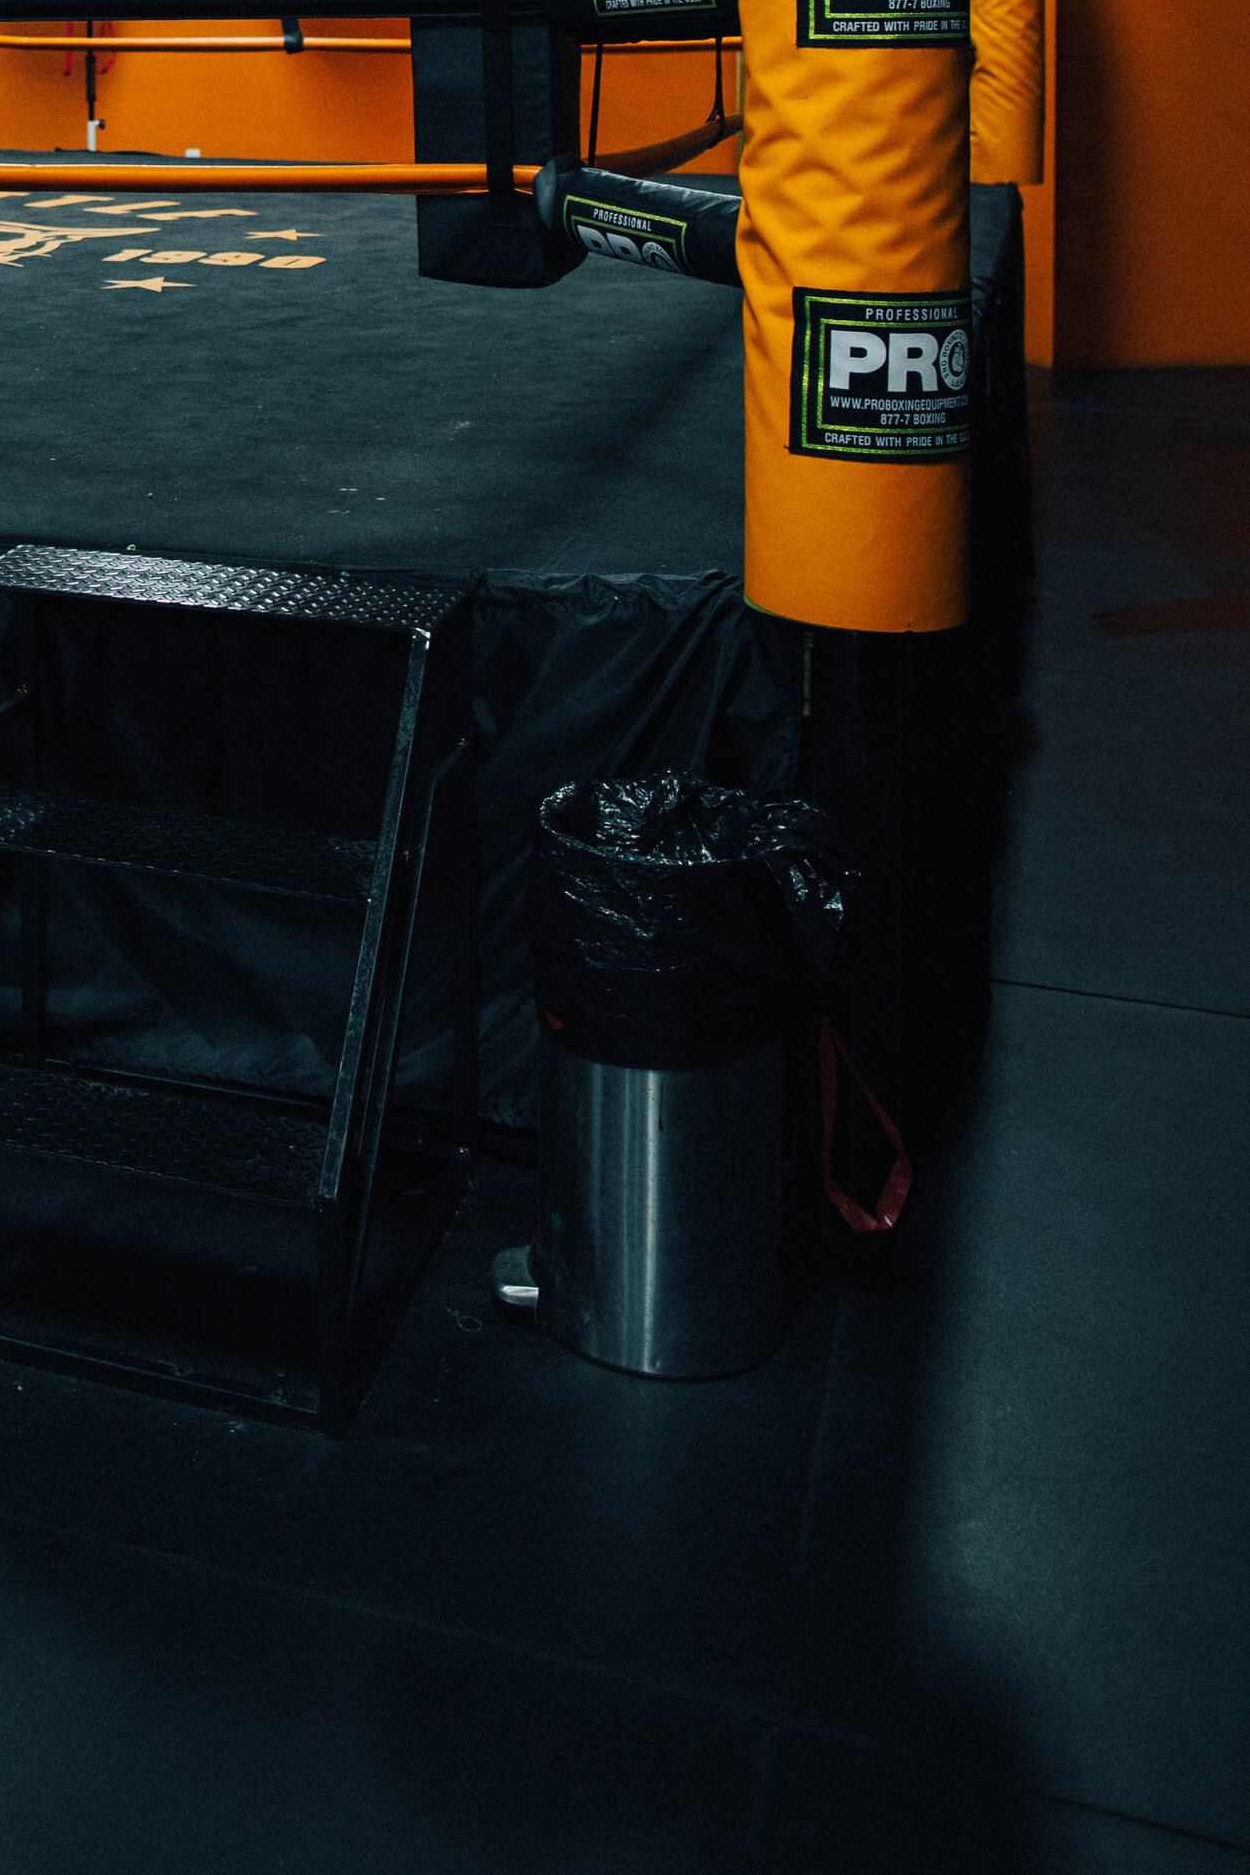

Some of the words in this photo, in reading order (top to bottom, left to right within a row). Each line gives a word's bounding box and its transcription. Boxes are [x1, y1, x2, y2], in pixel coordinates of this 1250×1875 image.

[606, 0, 629, 10] CRAFTED
[833, 21, 880, 32] CRAFTED
[884, 21, 910, 32] WITH
[914, 21, 938, 31] PRIDE
[941, 20, 948, 30] IN
[593, 208, 652, 232] PROFESSIONAL
[101, 248, 327, 269] 1990
[866, 307, 958, 321] PROFESSIONAL
[829, 329, 969, 392] PRO
[880, 413, 910, 425] 877-7
[913, 412, 946, 425] BOXING
[825, 432, 871, 446] CRAFTED
[875, 436, 902, 447] WITH
[906, 436, 932, 447] PRIDE
[936, 435, 943, 446] IN
[946, 434, 958, 444] THE
